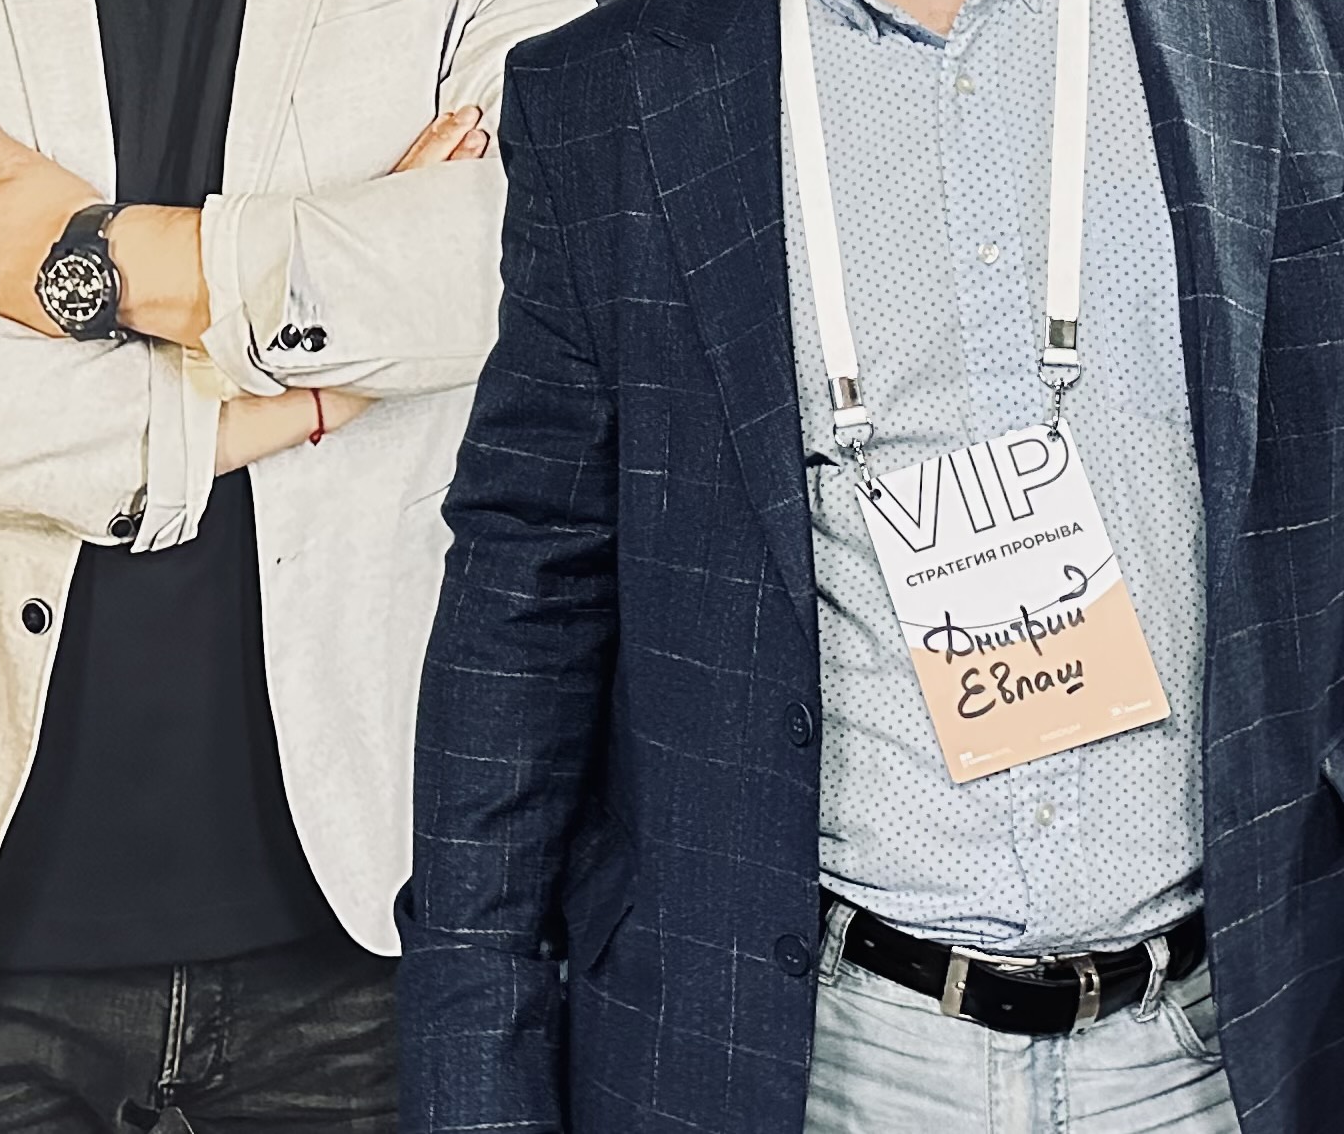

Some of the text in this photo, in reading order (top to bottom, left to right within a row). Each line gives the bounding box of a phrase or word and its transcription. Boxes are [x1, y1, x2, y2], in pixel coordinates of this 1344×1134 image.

[855, 424, 1069, 553] VIP
[906, 522, 1084, 587] СТРАТЕГИЯ ПРОРЫВА
